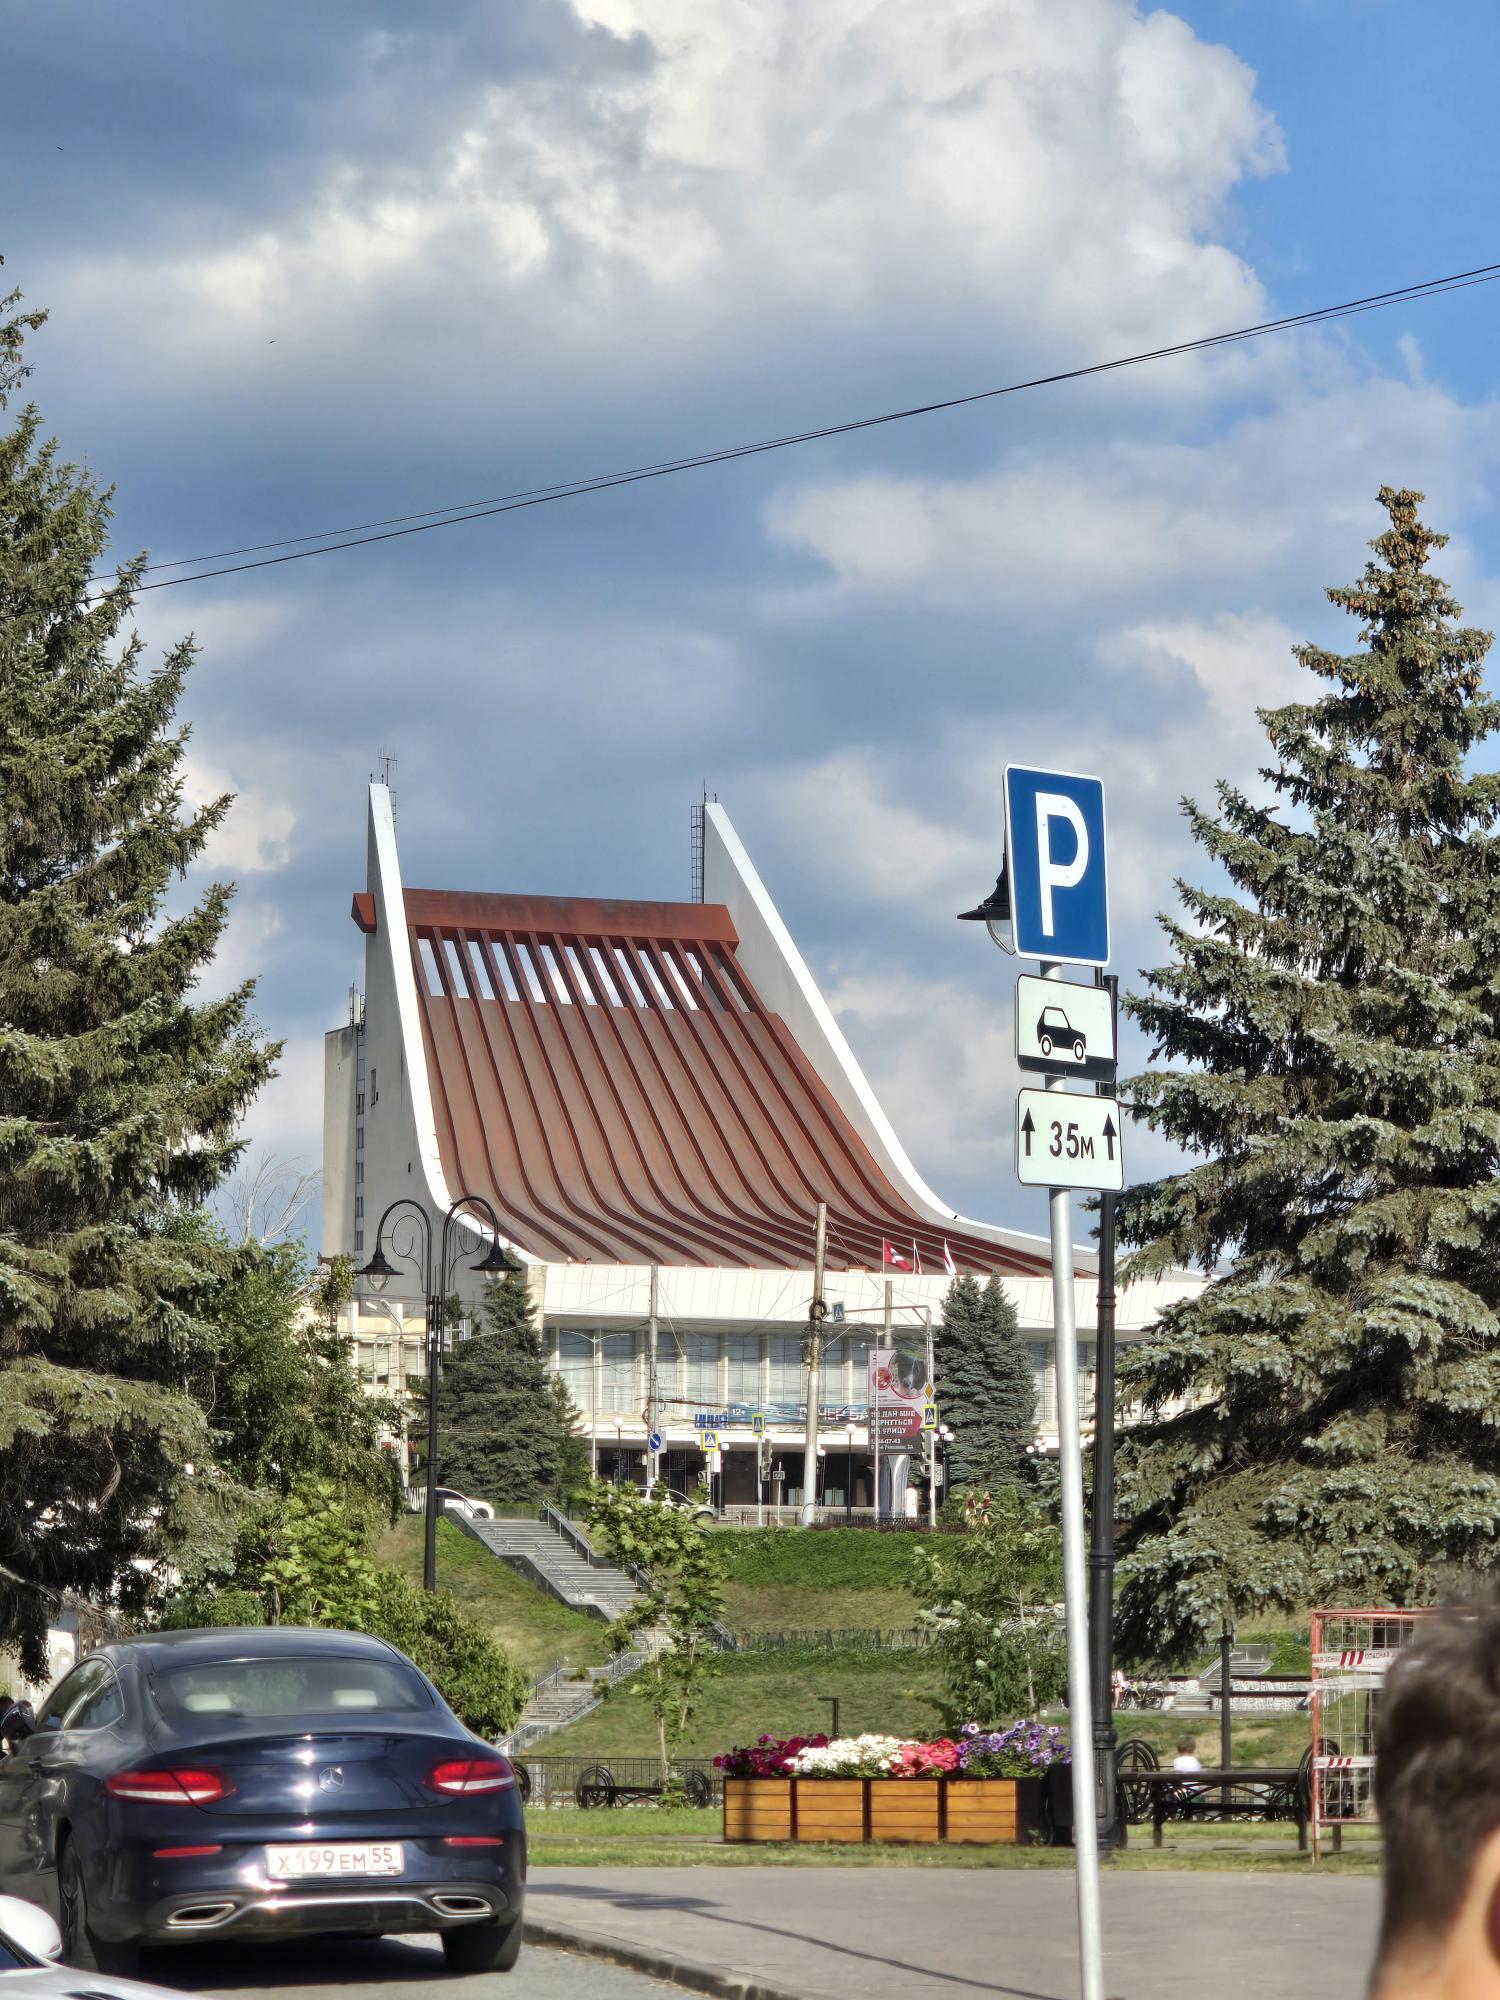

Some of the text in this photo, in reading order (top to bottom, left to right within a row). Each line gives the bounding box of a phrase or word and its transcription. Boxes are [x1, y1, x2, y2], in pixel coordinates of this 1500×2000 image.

[1035, 791, 1089, 937] P
[799, 1407, 846, 1421] ВЧЕР
[372, 1847, 392, 1863] 55
